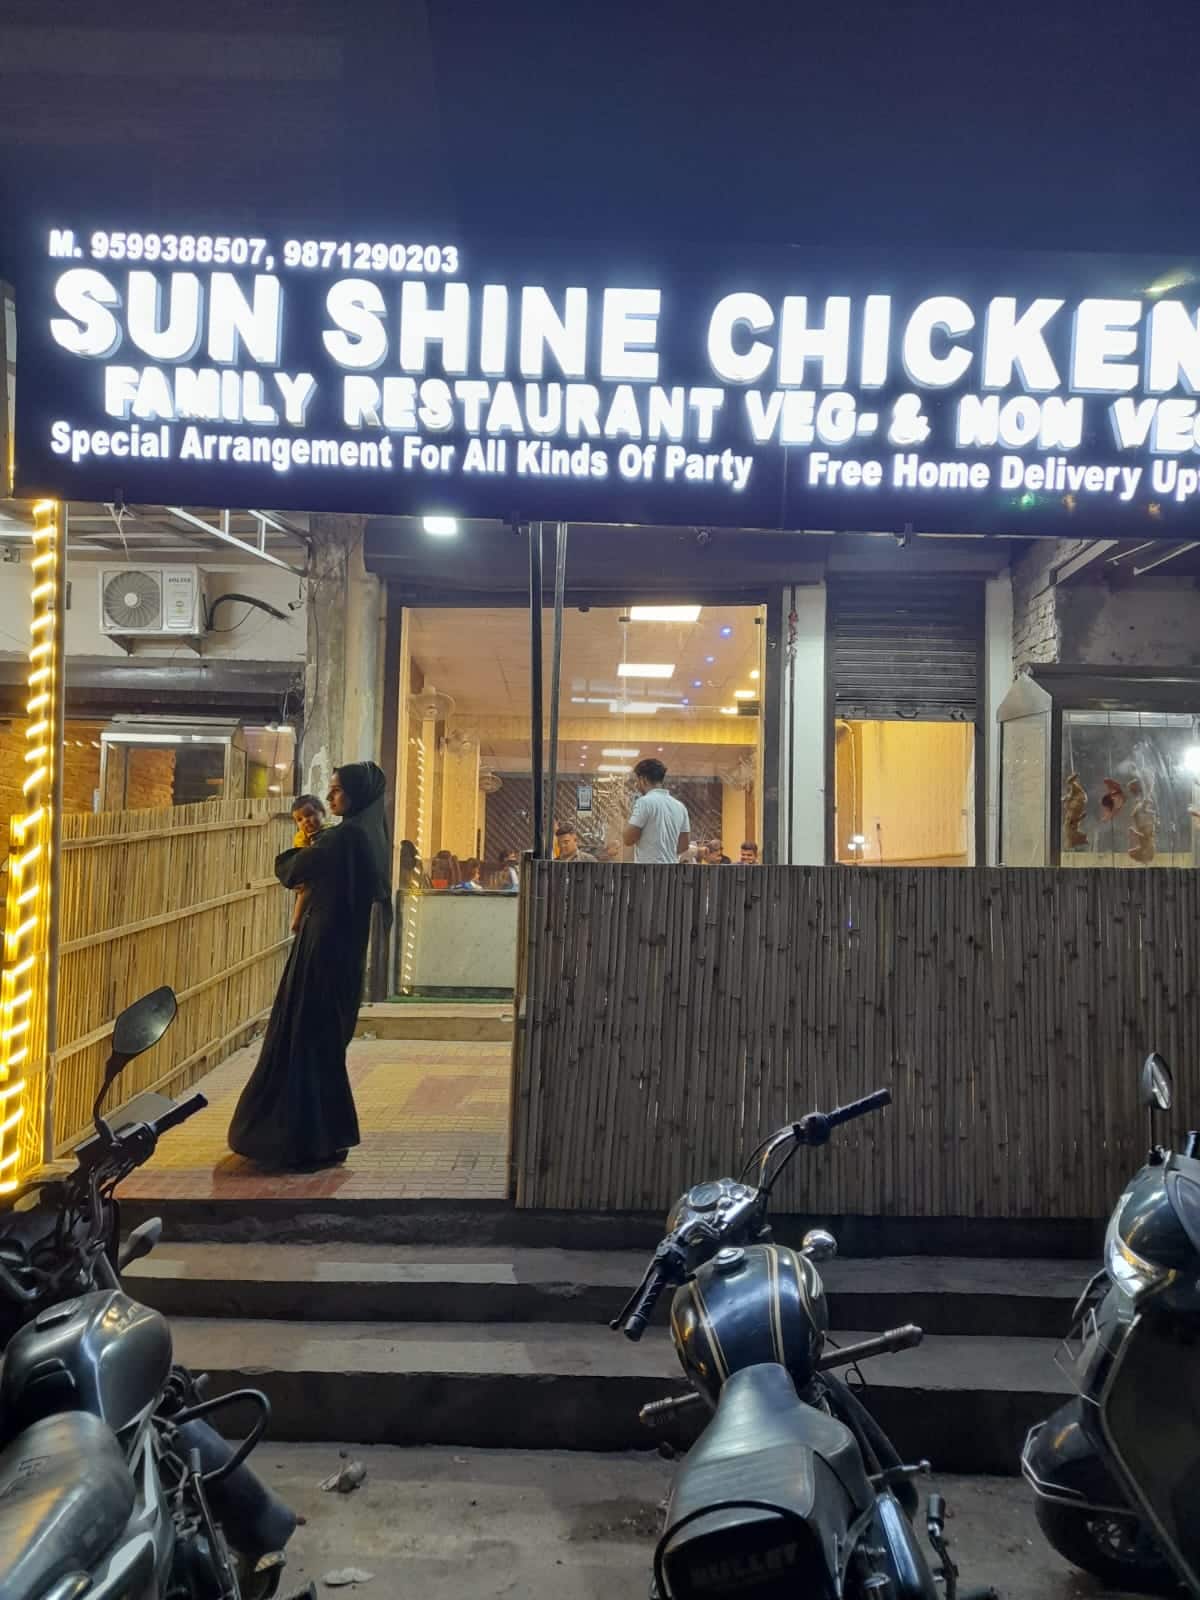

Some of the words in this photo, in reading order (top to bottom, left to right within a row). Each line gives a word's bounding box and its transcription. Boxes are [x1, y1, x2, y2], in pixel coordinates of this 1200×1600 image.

[49, 230, 82, 259] M.
[91, 231, 274, 270] 9599388507,
[284, 239, 458, 274] 9871290203
[50, 268, 284, 365] SUN
[322, 279, 662, 382] SHINE
[706, 292, 1200, 396] CHICKEN
[104, 366, 315, 427] FAMILY
[343, 377, 724, 442] RESTAURANT
[886, 393, 931, 445] &
[956, 396, 1083, 450] NON
[1109, 397, 1200, 454] VE
[51, 422, 168, 461] Special
[181, 428, 391, 471] Arrangement
[404, 437, 454, 471] For
[464, 441, 506, 475] All
[517, 441, 607, 479] Kinds
[619, 446, 657, 480] Of
[665, 448, 753, 490] Party
[809, 453, 882, 487] Free
[894, 454, 990, 490] Home
[1001, 456, 1142, 501] Delivery
[1153, 460, 1200, 502] Up
